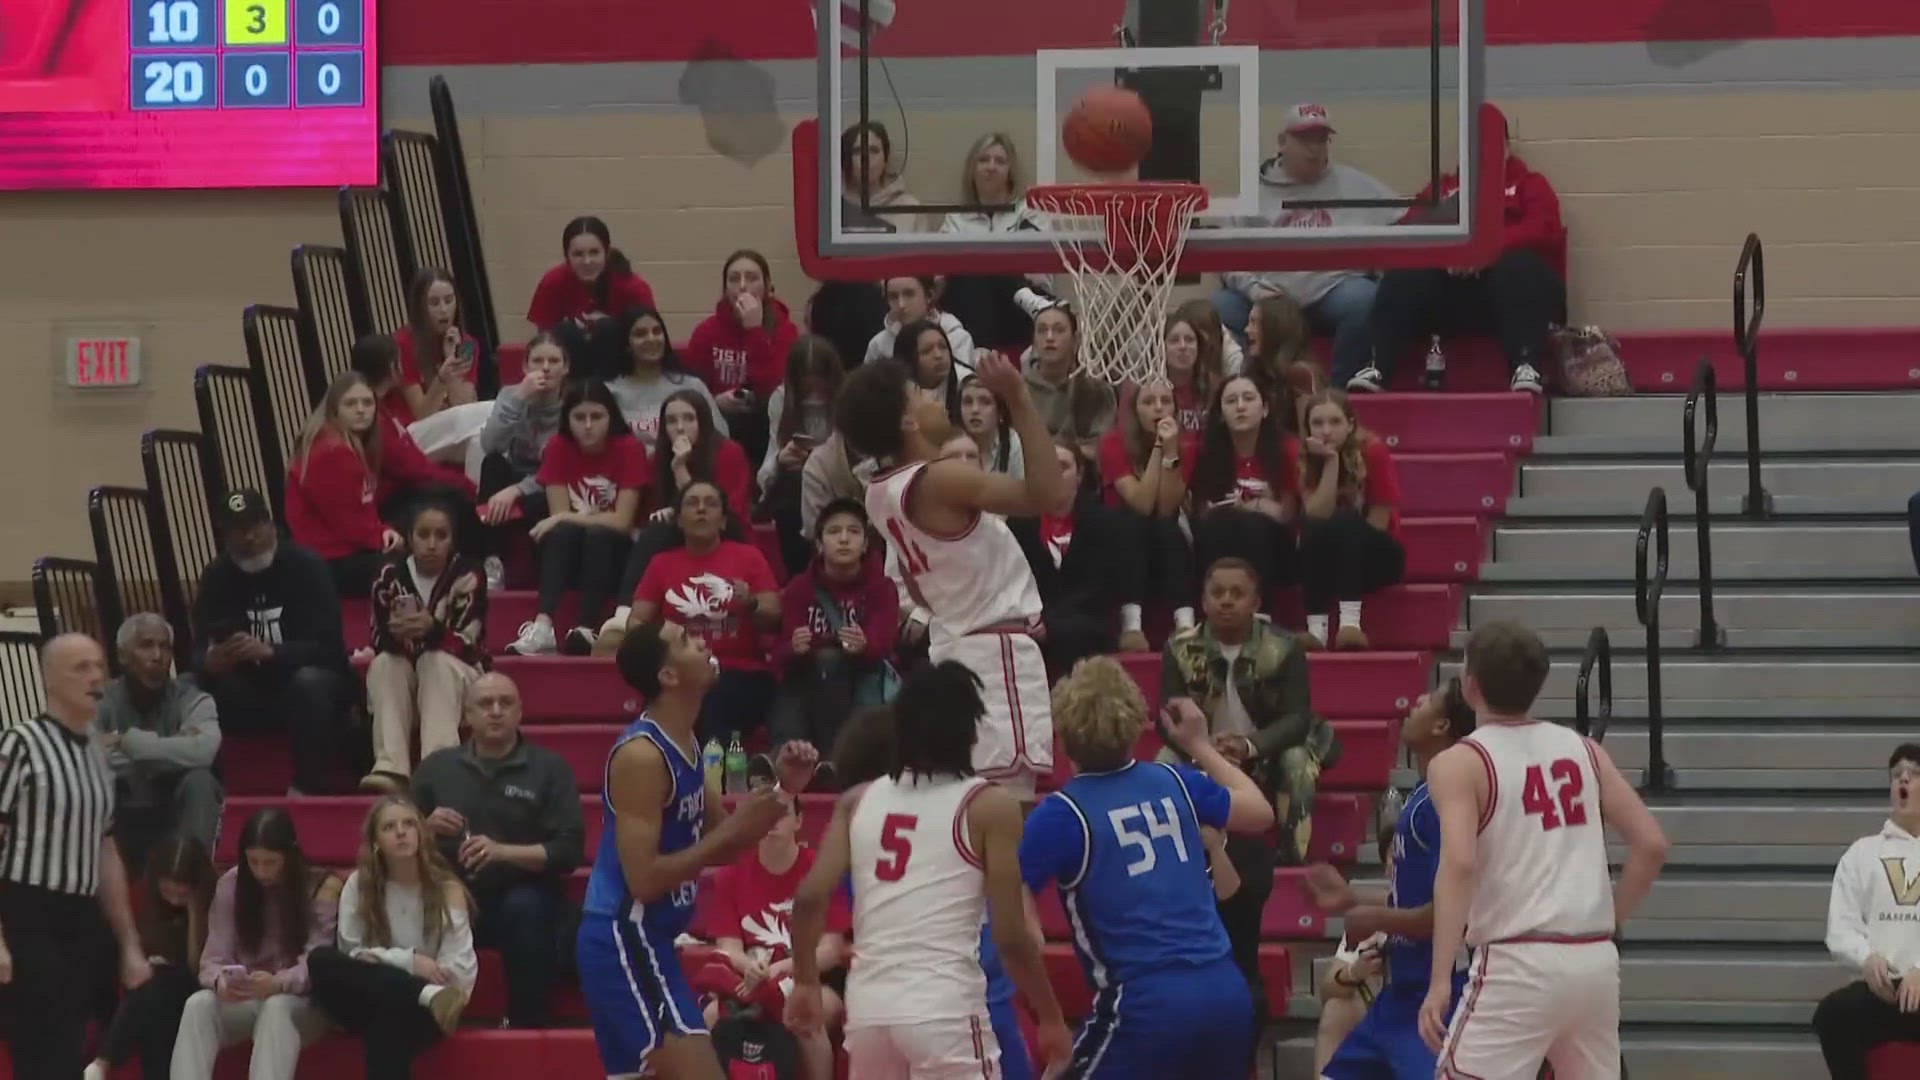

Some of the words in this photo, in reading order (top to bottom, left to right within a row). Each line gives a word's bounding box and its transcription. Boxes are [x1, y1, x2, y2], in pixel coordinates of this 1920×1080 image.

[149, 0, 199, 42] 10
[246, 5, 267, 34] 3
[318, 3, 340, 35] 0
[145, 61, 203, 103] 20
[245, 65, 267, 96] 0
[318, 64, 341, 95] 0
[78, 340, 128, 384] EXIT
[1522, 757, 1587, 832] 42
[875, 813, 919, 883] 5
[1107, 796, 1189, 877] 54
[1879, 911, 1920, 922] BASEBA
